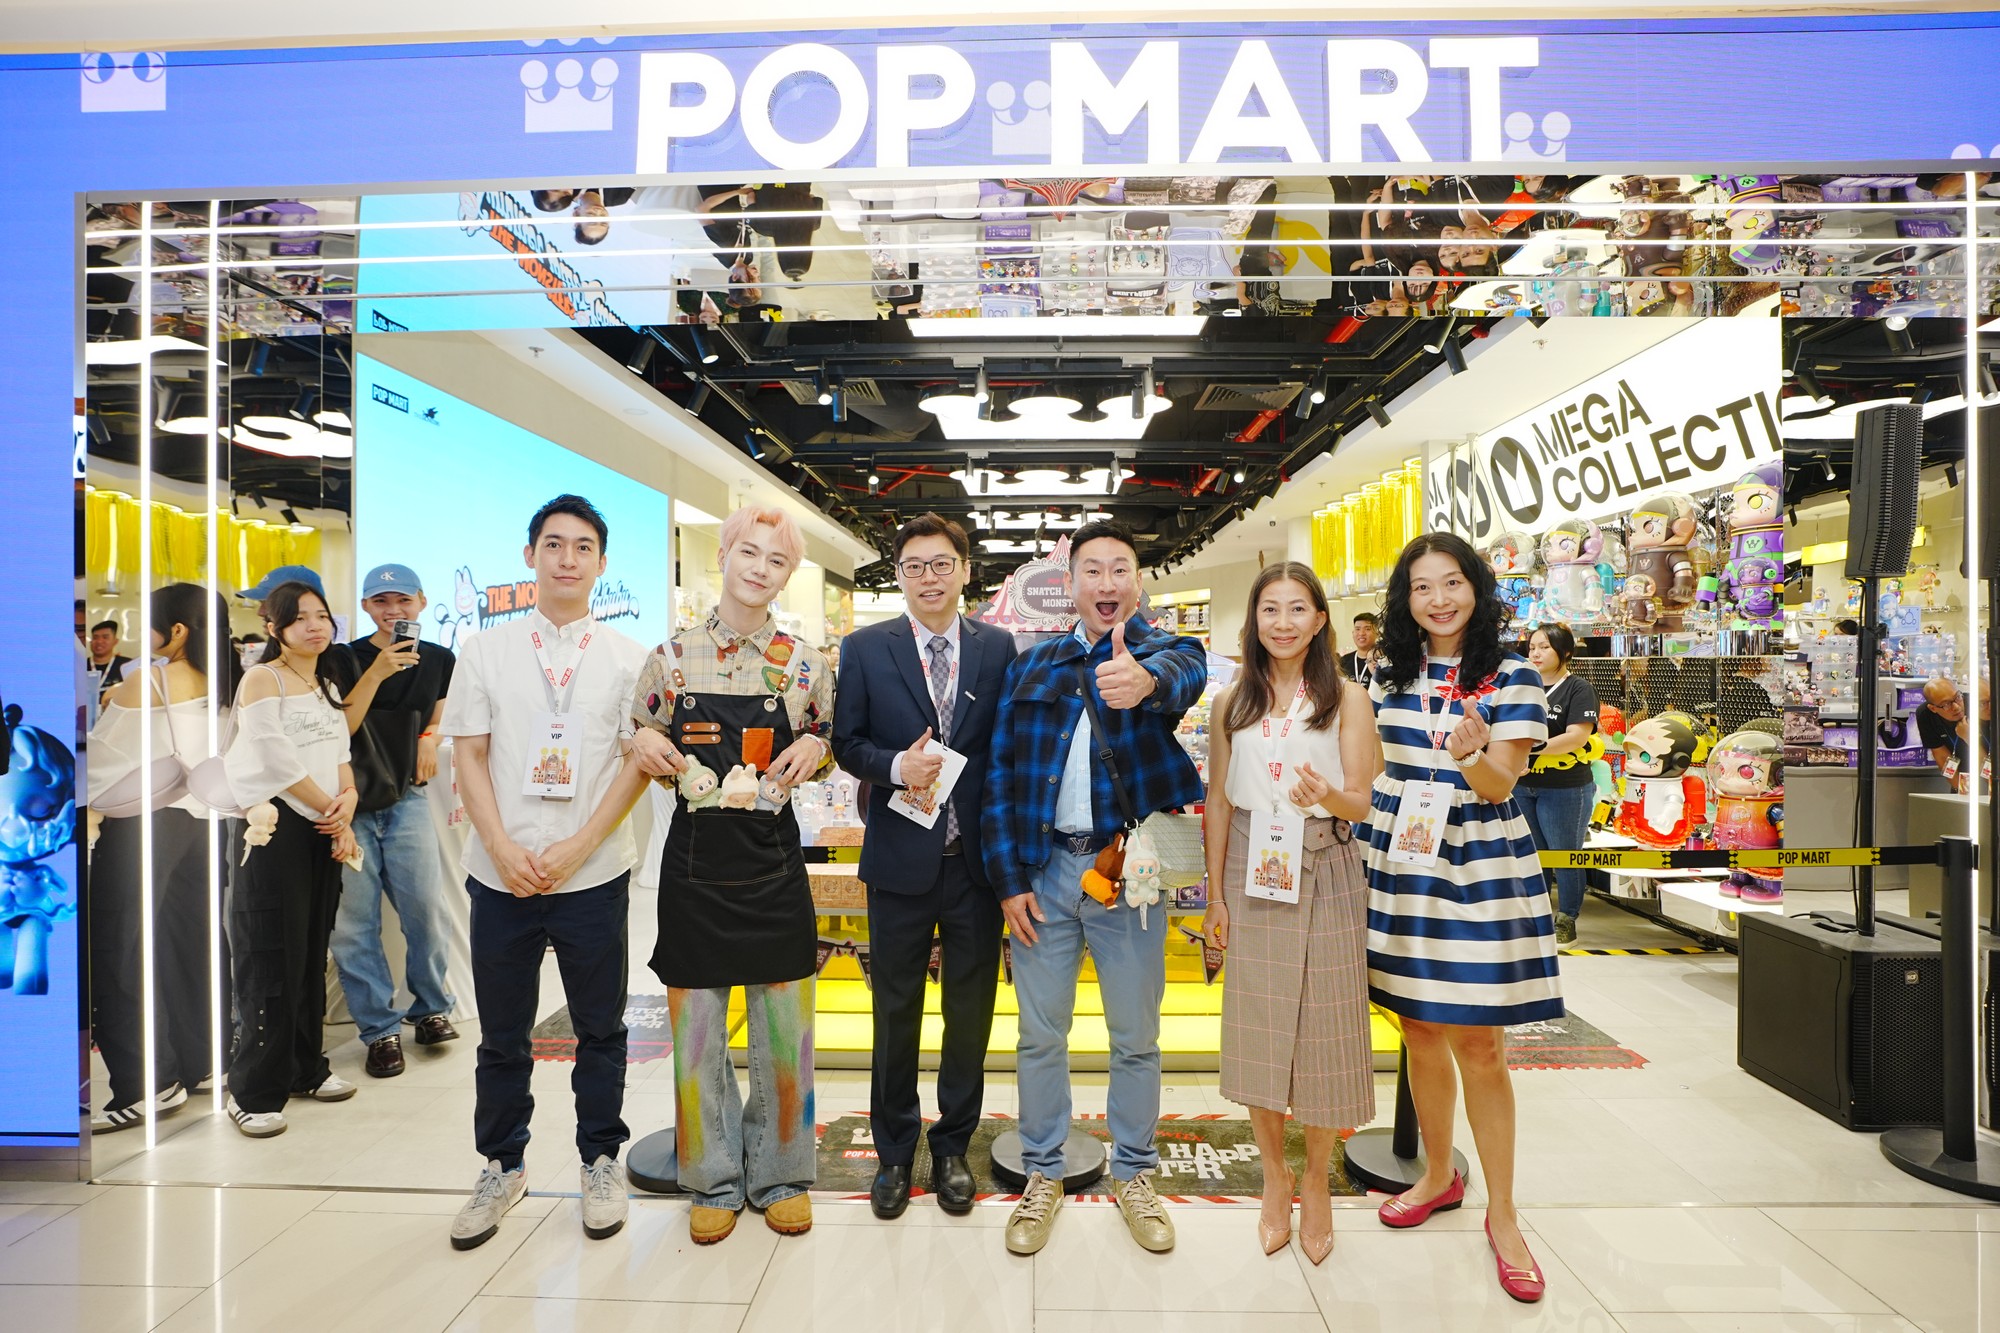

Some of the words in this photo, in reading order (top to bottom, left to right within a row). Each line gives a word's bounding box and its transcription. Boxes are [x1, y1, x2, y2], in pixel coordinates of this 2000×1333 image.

[635, 43, 976, 173] POP
[1050, 36, 1540, 167] MART
[374, 386, 388, 404] POP
[388, 392, 408, 410] MART
[1532, 379, 1652, 466] MEGA
[1552, 386, 1783, 512] COLLECTI
[486, 585, 513, 613] THE
[1026, 586, 1062, 596] SNATCH
[1570, 854, 1590, 866] POP
[1594, 854, 1622, 866] MART
[1778, 852, 1798, 864] POP
[1802, 852, 1830, 864] MART
